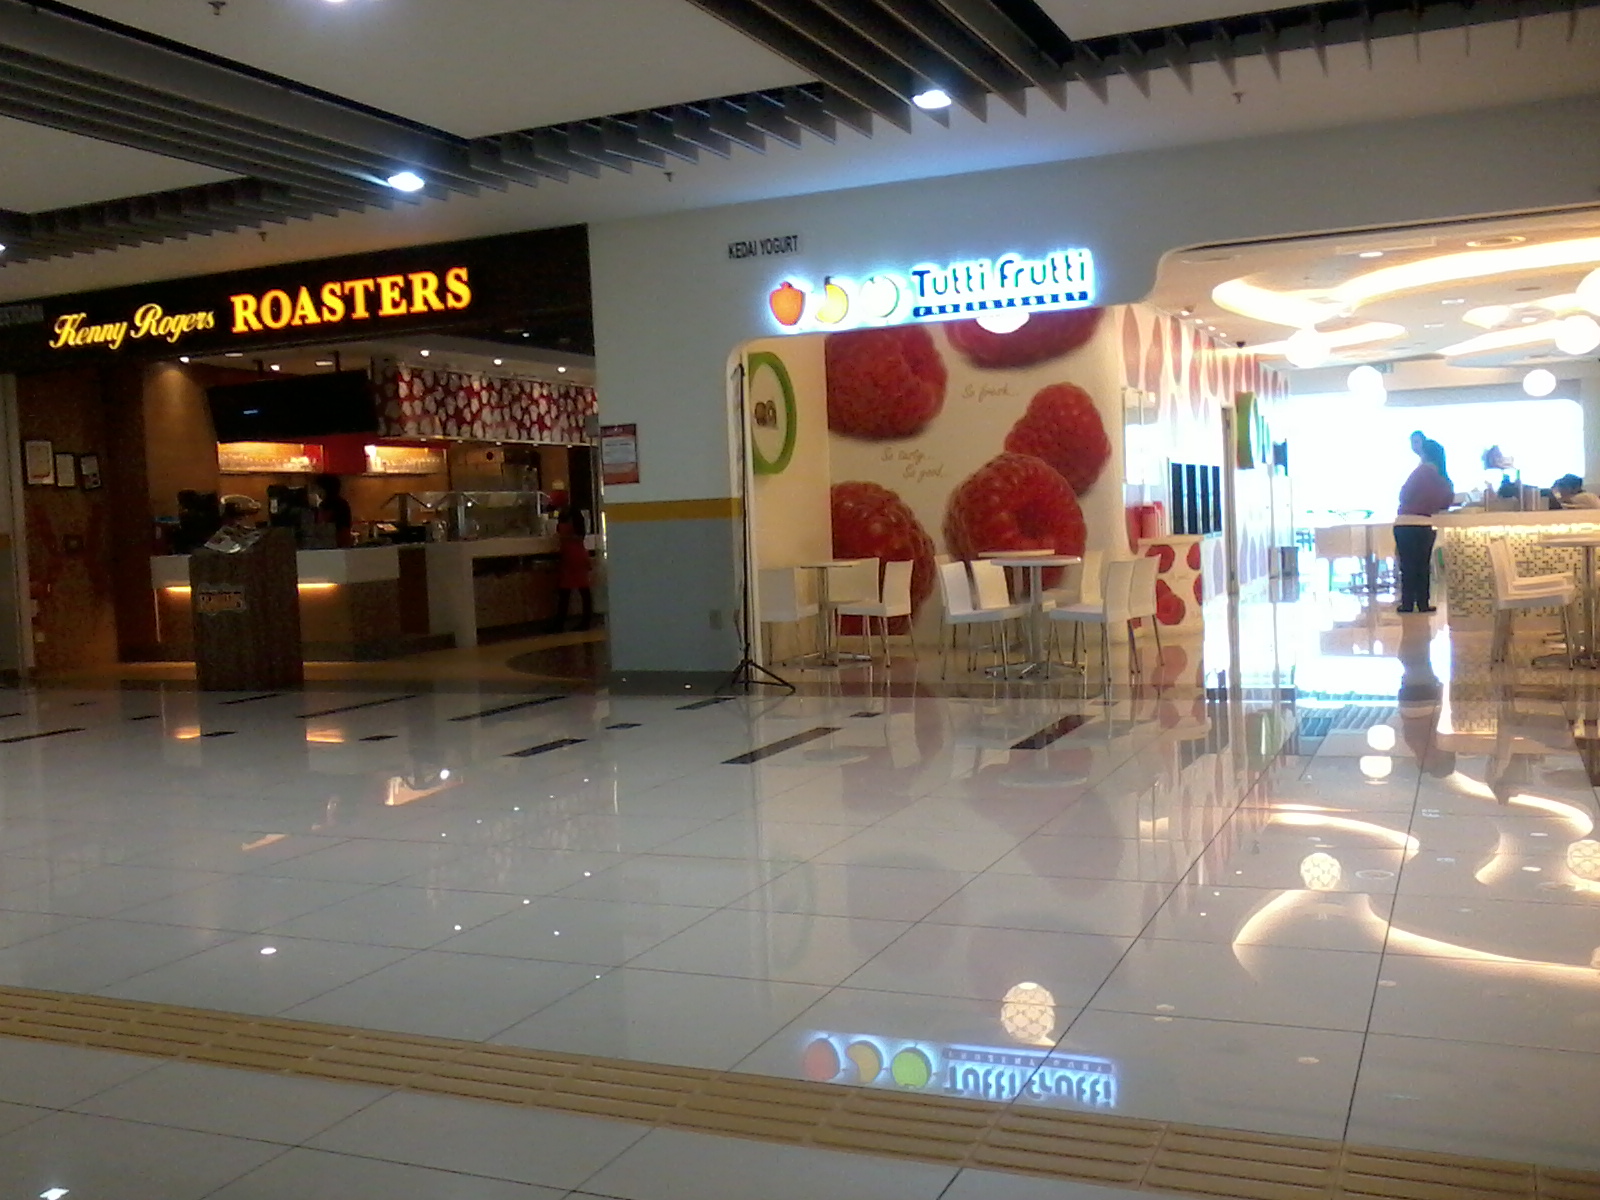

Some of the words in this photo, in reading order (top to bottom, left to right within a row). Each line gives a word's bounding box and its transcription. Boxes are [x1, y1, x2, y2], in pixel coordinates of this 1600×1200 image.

[728, 241, 757, 259] KEDAI
[760, 235, 798, 255] YOGURT
[912, 263, 985, 298] Tutti
[49, 312, 128, 350] Kenny
[130, 303, 215, 343] Rogers
[230, 266, 472, 333] ROASTERS
